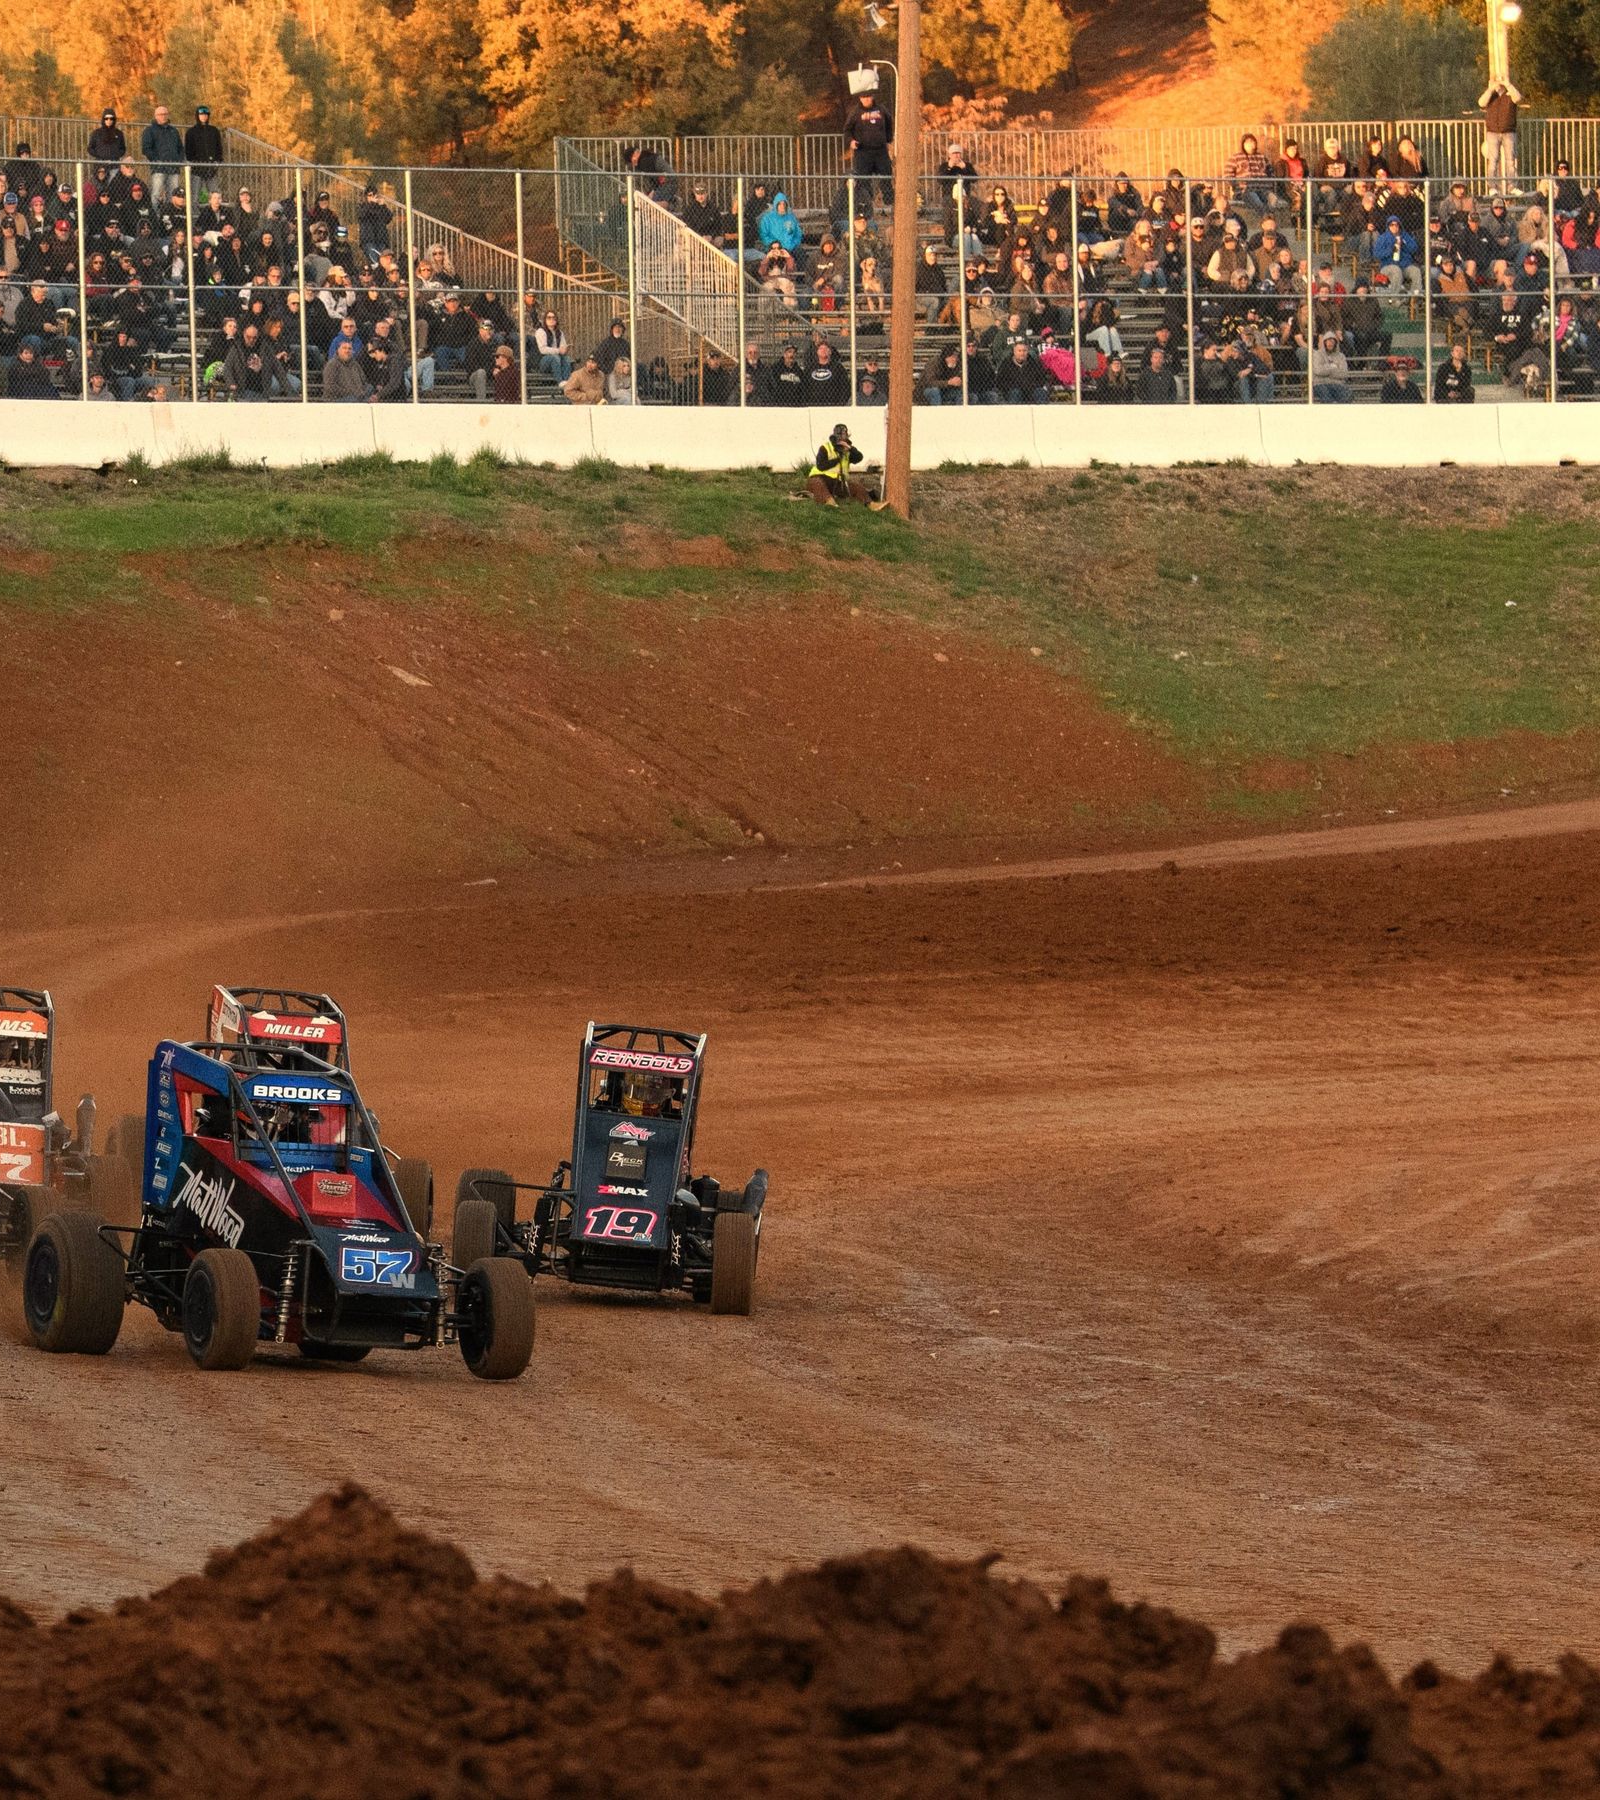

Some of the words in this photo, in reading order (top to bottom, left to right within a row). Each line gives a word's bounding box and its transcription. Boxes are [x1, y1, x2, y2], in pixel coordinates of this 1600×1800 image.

[264, 1023, 325, 1039] MILLER
[594, 1051, 691, 1070] REINBOLD
[253, 1085, 342, 1101] BROOKS
